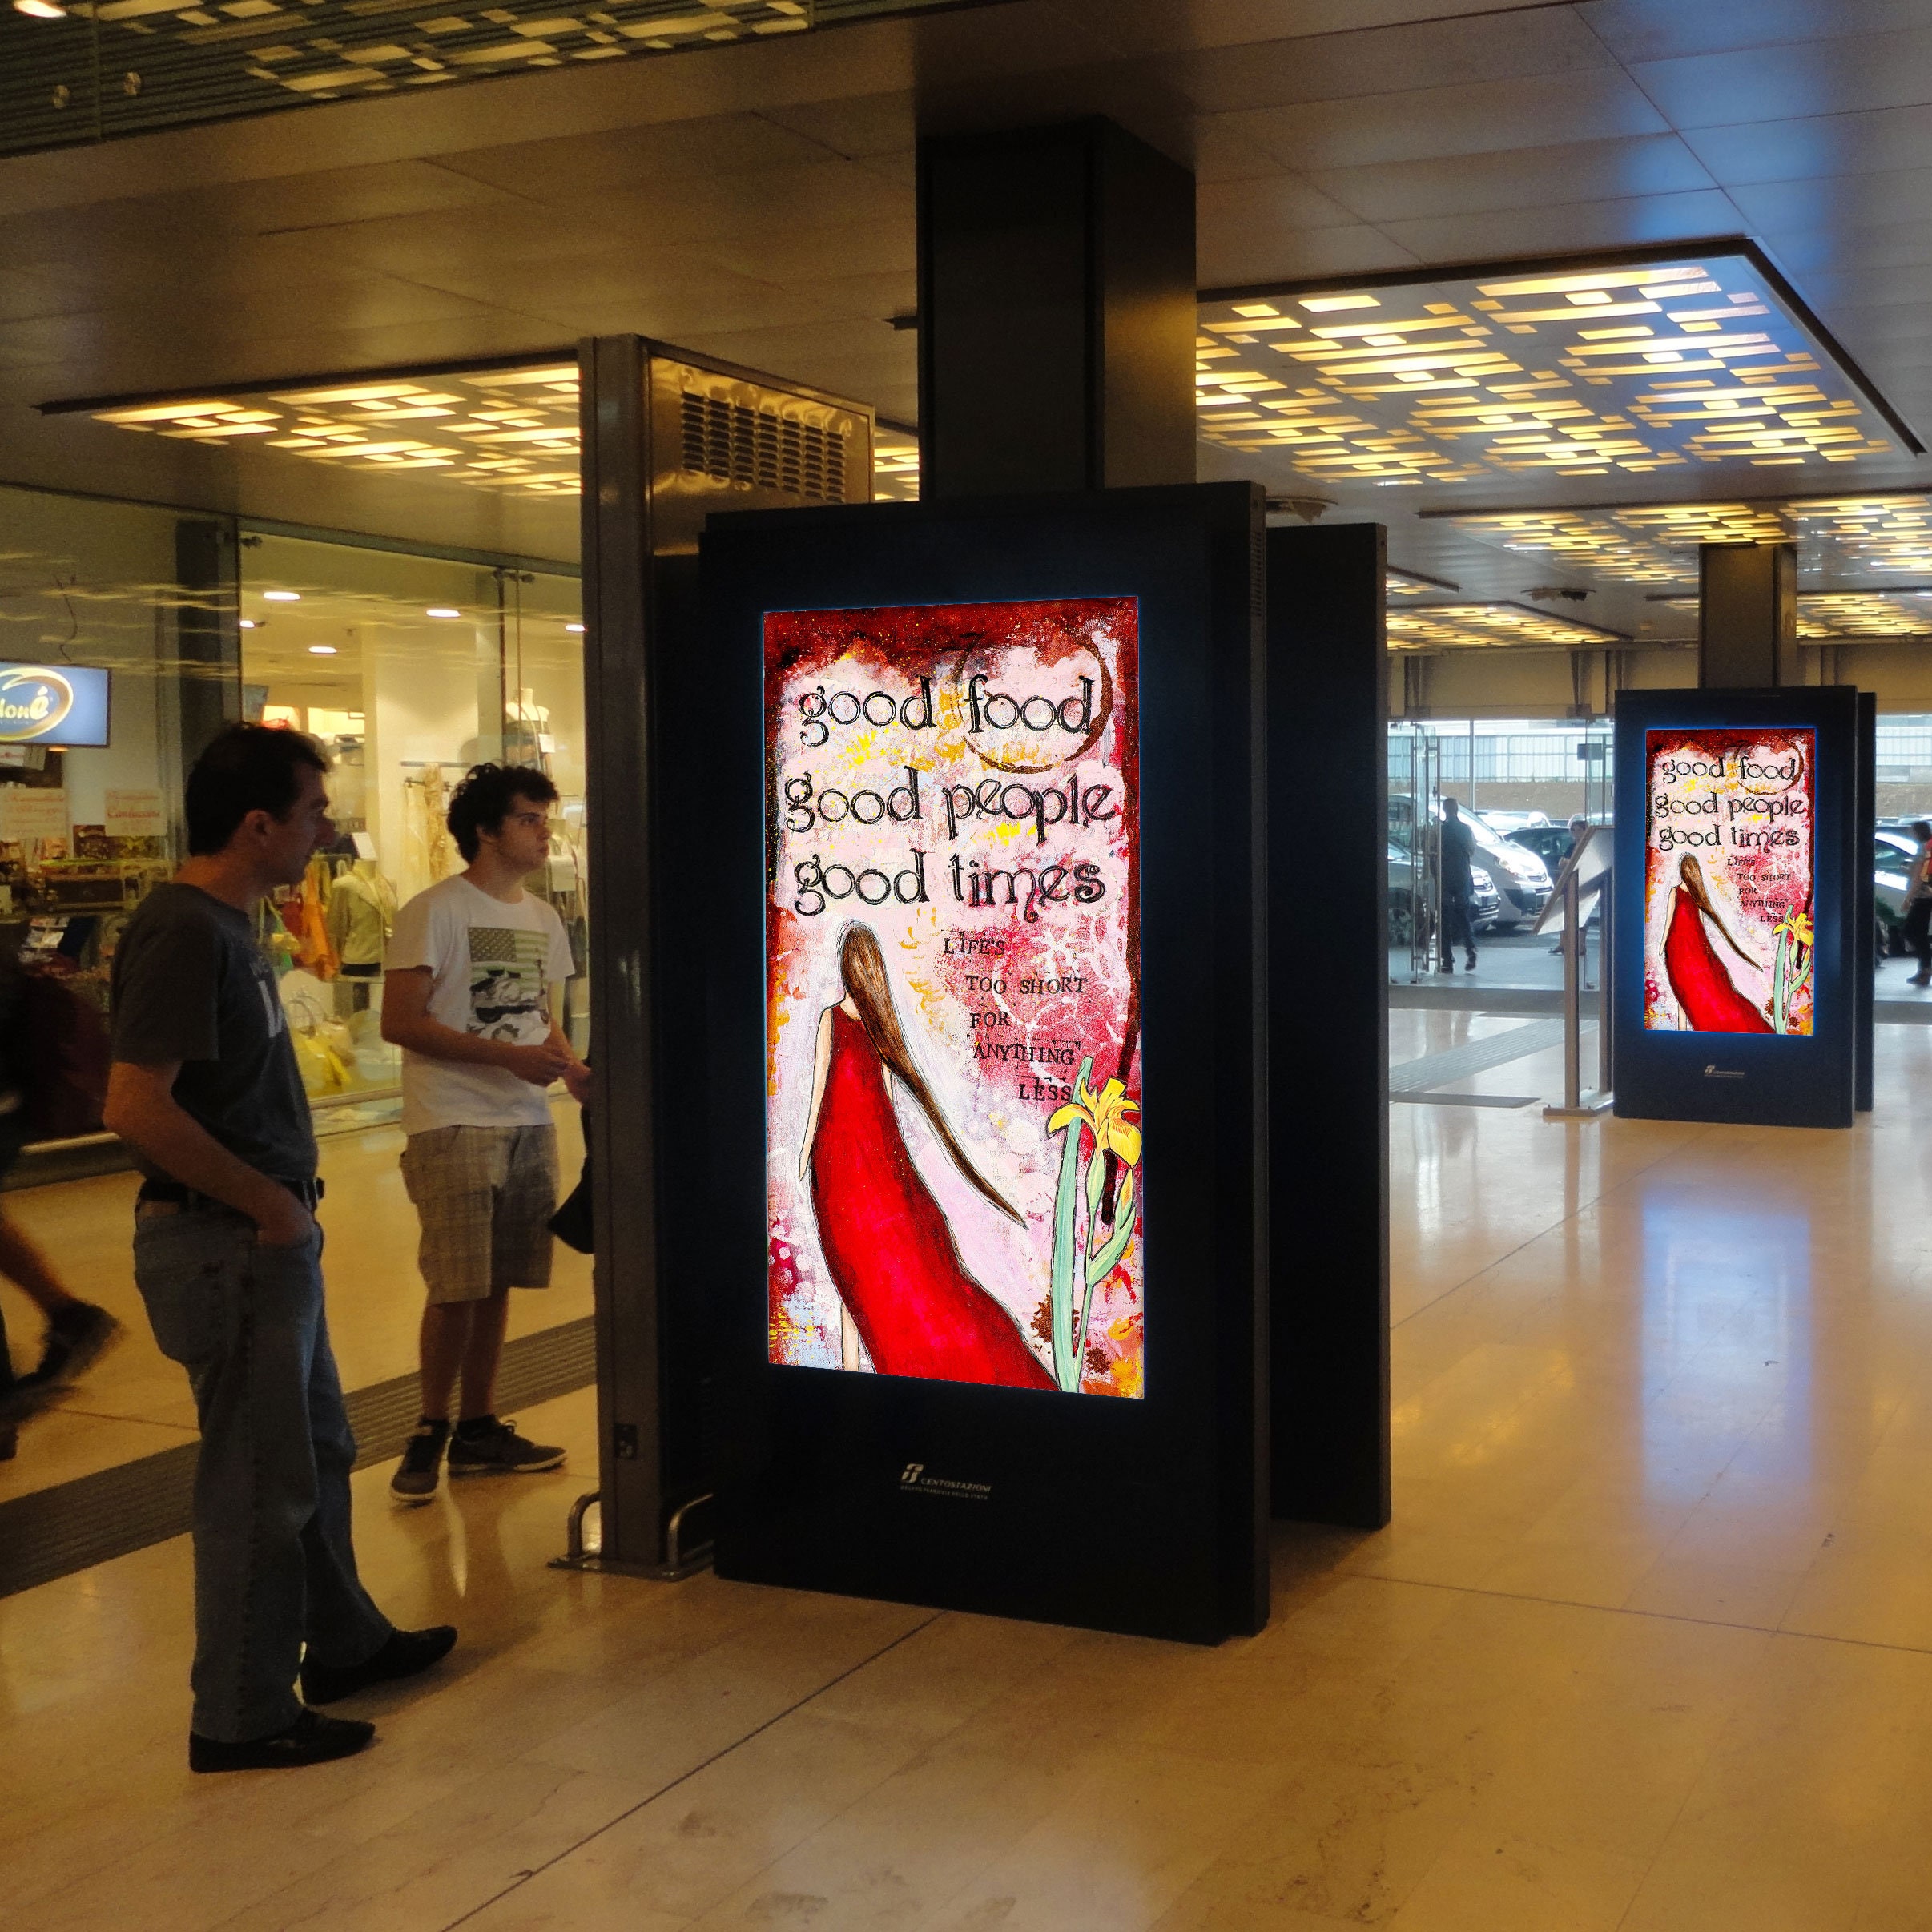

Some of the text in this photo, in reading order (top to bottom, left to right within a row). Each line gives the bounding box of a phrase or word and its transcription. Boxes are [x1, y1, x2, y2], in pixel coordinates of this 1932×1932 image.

[799, 674, 1094, 747] good food
[1662, 756, 1796, 783] good food
[784, 766, 1117, 845] good people
[1655, 791, 1804, 823] good people
[1660, 824, 1800, 853] good times
[794, 849, 1106, 923] good times
[1761, 873, 1791, 881] SHORT
[1761, 913, 1783, 922] LESS
[944, 932, 1005, 956] LIFE'S
[966, 976, 1088, 995] TOO SHORT
[970, 1012, 1011, 1028] FOR
[1019, 1078, 1071, 1101] LESS
[920, 1478, 992, 1491] CENTOSTAZIONI
